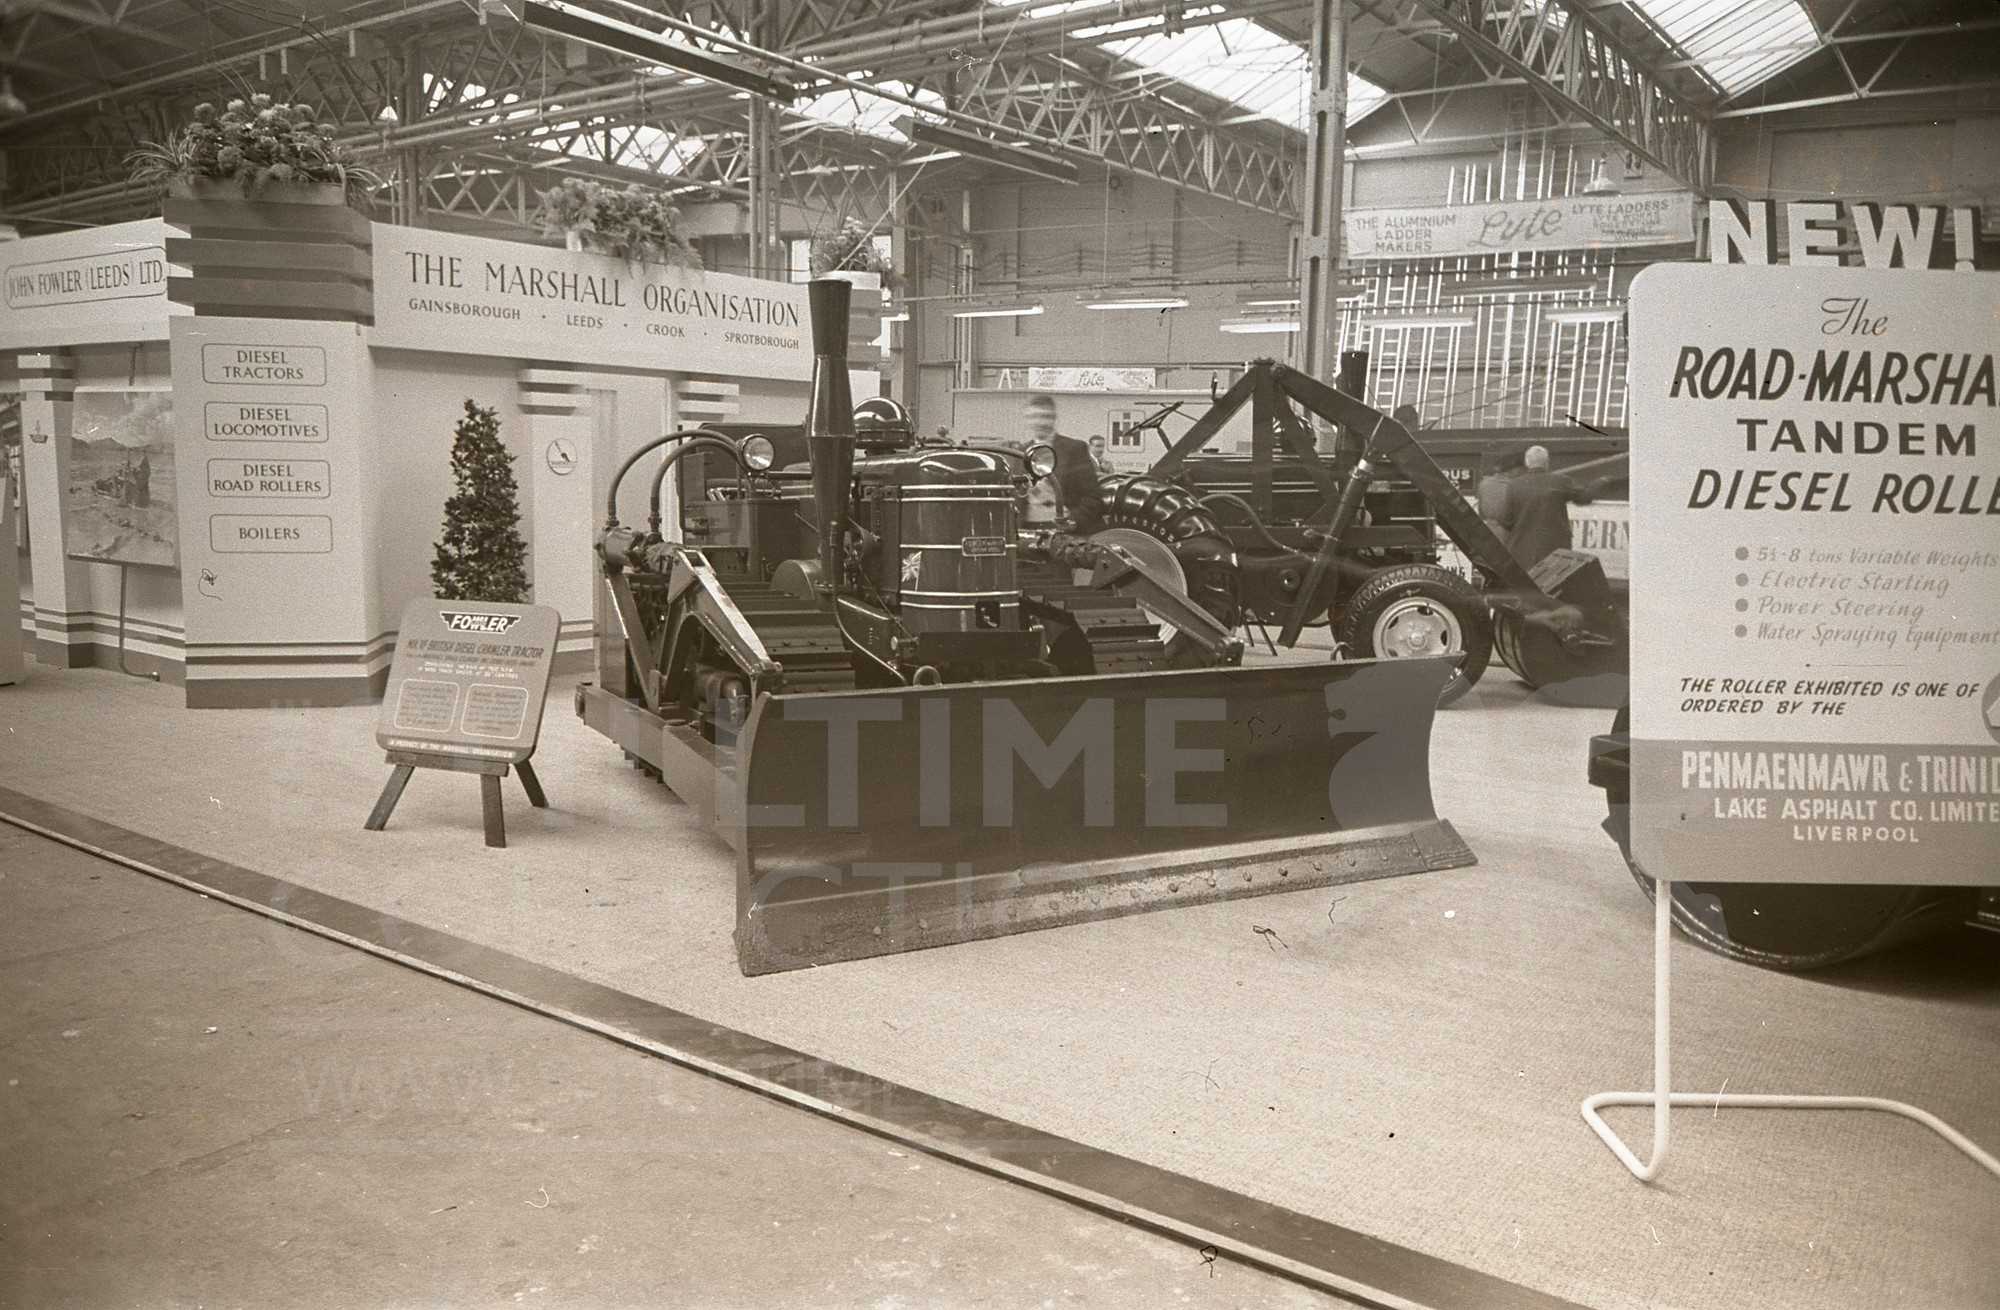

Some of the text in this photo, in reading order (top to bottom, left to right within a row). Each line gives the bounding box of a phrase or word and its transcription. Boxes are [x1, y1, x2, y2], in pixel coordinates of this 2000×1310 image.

[1608, 199, 1669, 213] LADDERS
[1355, 214, 1456, 230] THE ALUMINIUM
[1466, 207, 1562, 248] Lyte
[1376, 228, 1431, 240] LADDER
[1709, 199, 1977, 272] NEW!
[1376, 241, 1432, 252] MAKERS
[9, 274, 34, 299] JOHN
[38, 270, 82, 295] FOWLER
[140, 260, 165, 284] LTD.
[405, 251, 799, 328] THE MARSHALL ORGANISATION
[409, 298, 799, 350] GAINSBOROUGH LEEDS CROOK SPROTBOROUGH
[1821, 298, 1889, 336] The
[237, 350, 288, 364] DIESEL
[223, 366, 304, 379] TRACTORS
[1670, 346, 2000, 407] ROAD-MARSHA
[240, 408, 292, 421] DIESEL
[214, 424, 319, 437] LOCOMOTIVES
[1737, 418, 1976, 456] TANDEM
[243, 464, 294, 477] DIESEL
[214, 480, 321, 492] ROAD ROLLERS
[1688, 469, 1852, 512] DIESEL
[239, 527, 300, 540] BOILERS
[1809, 548, 1842, 562] tons
[1849, 548, 1921, 564] Variable
[1926, 550, 2000, 572] Weights
[1760, 570, 1949, 598] Electric Starting
[1759, 596, 1924, 624] Power Steering
[450, 614, 508, 631] FOWLER
[1758, 622, 2000, 652] Water Spraying Equipment
[1680, 678, 1980, 697] THE ROLLER EXHIBITED IS ONE OF
[1680, 699, 1846, 716] ORDERED BY THE
[1681, 751, 1890, 792] PENMAENMAWR
[1900, 761, 1913, 792] &
[1714, 797, 1767, 819] LAKE
[1781, 799, 1877, 820] ASPHALT
[1890, 801, 1922, 821] CO.
[1793, 826, 1919, 843] LIVERPOOL
